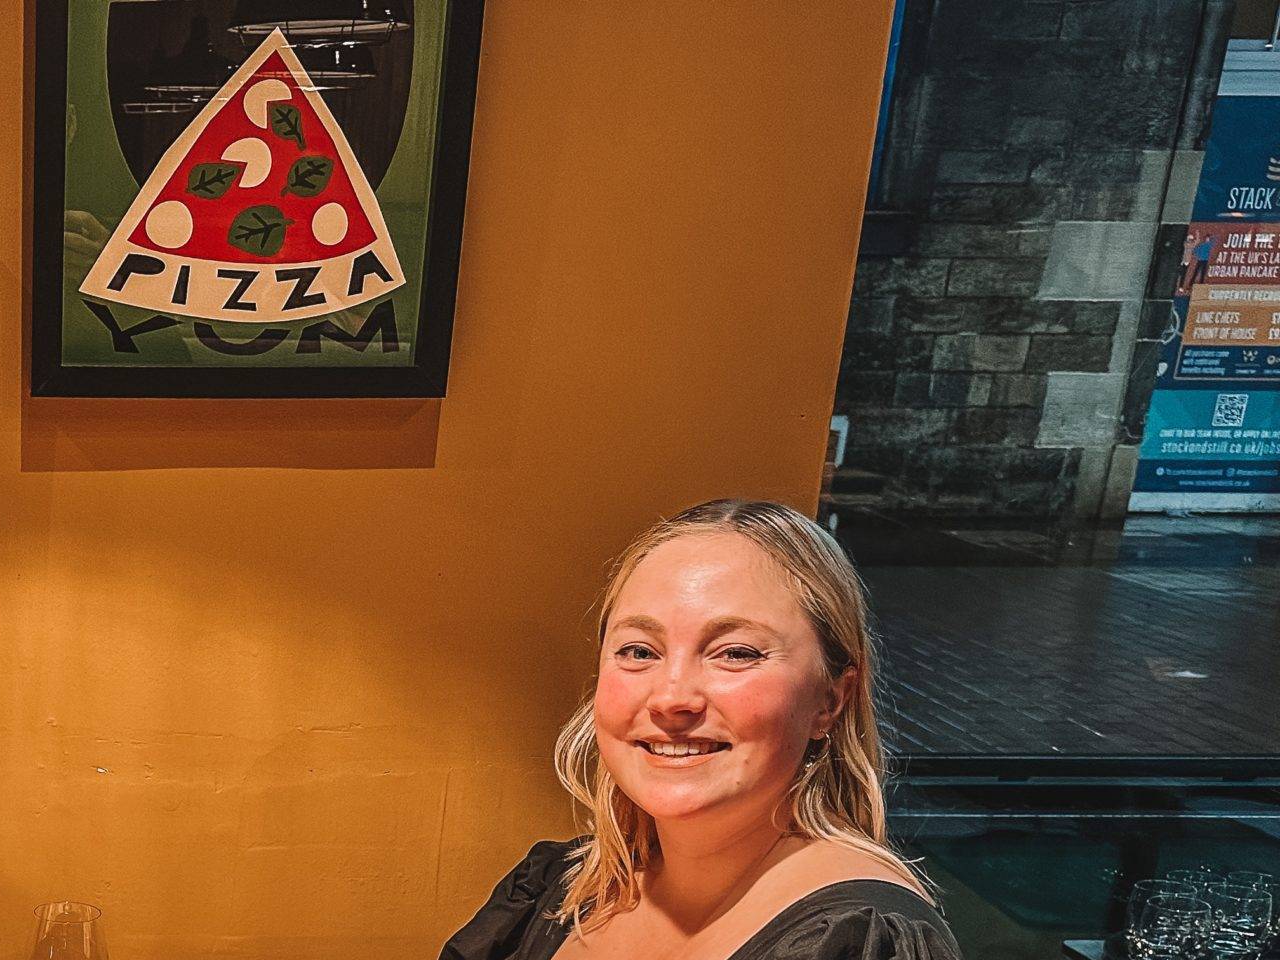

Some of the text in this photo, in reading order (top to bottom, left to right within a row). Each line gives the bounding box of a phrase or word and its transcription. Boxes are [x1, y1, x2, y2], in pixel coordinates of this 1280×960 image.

[1227, 187, 1276, 210] STACK
[1223, 233, 1252, 248] JOIN
[1254, 233, 1276, 248] THE
[1216, 251, 1228, 264] AT
[1230, 251, 1247, 264] THE
[1247, 251, 1269, 264] UK'S
[1207, 265, 1280, 278] URBAN PANCAKE
[106, 249, 395, 312] PIZZA
